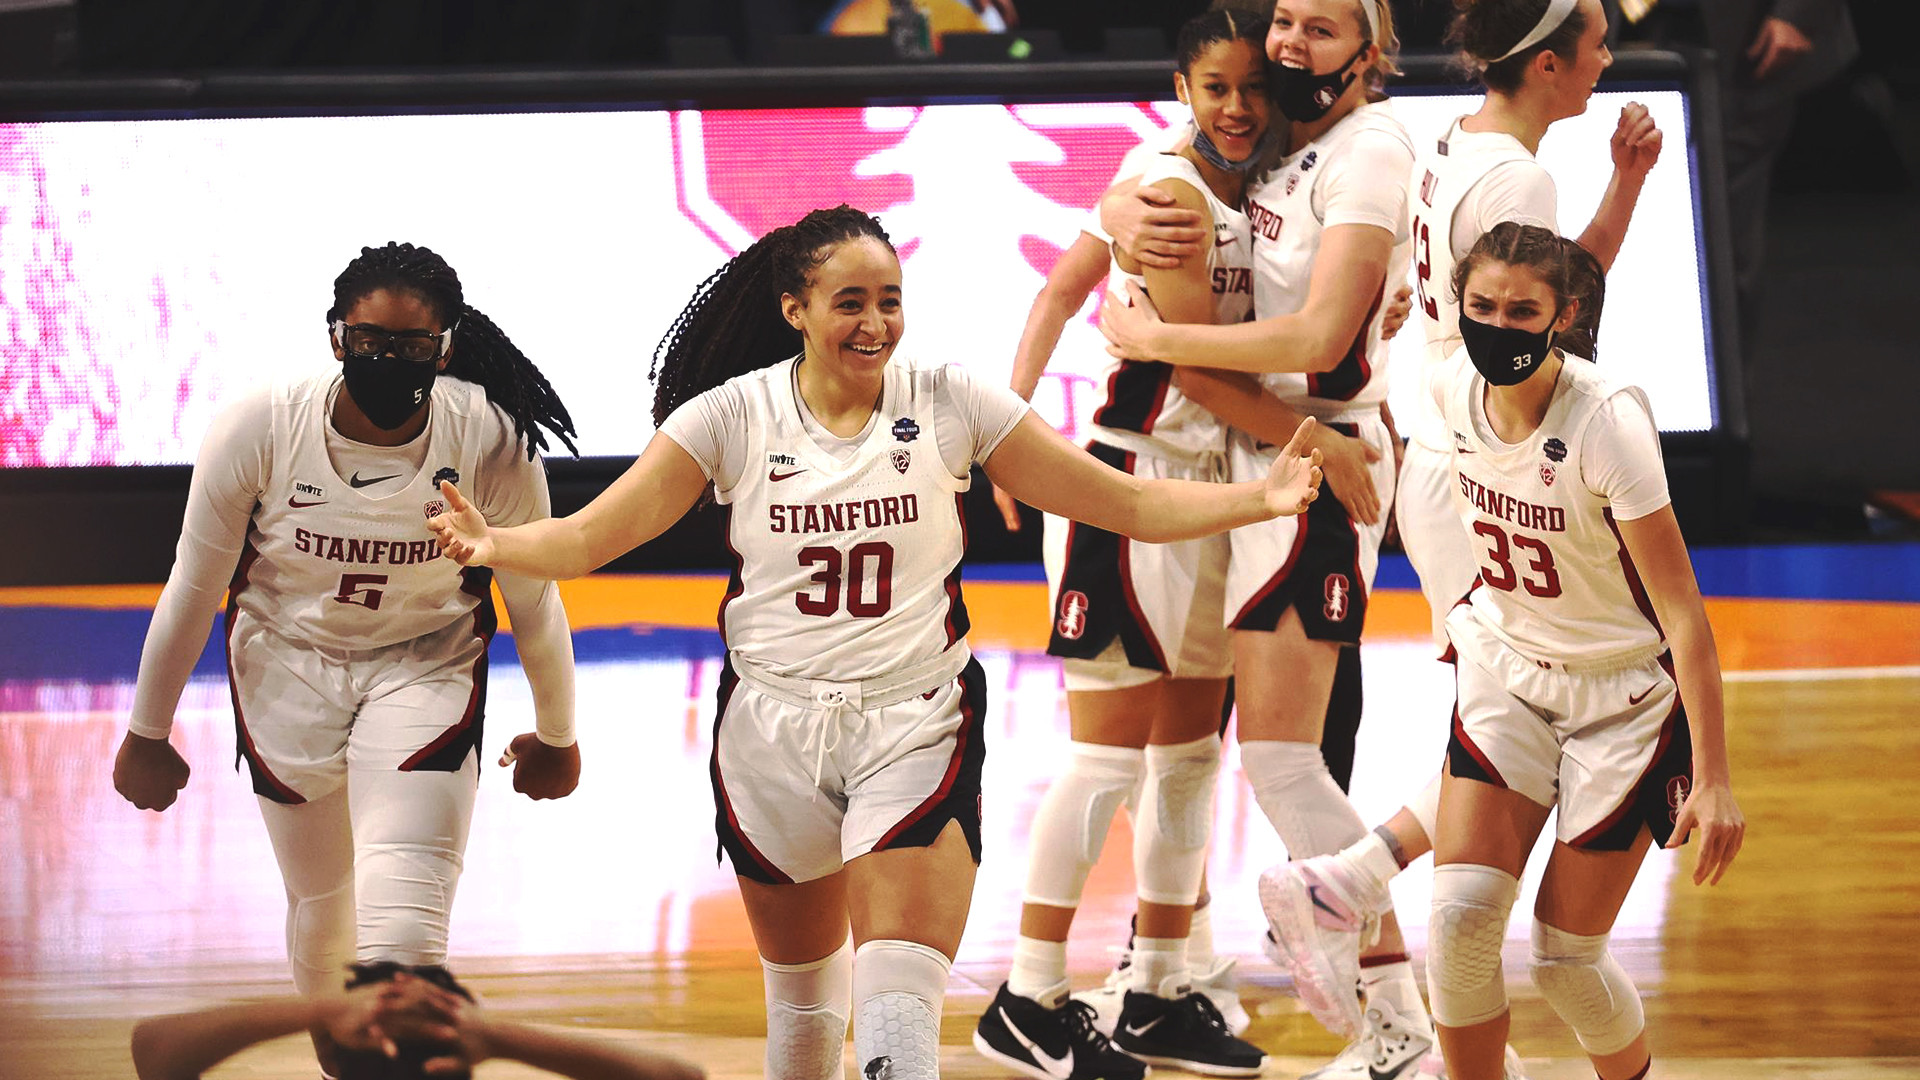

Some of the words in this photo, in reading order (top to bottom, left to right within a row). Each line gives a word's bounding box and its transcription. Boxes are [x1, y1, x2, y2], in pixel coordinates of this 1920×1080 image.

[1513, 354, 1531, 370] 33
[414, 388, 423, 404] 5
[896, 459, 908, 471] 12
[769, 493, 919, 534] STANFORD
[1458, 471, 1567, 532] STANFORD
[1472, 519, 1563, 598] 33
[334, 573, 388, 611] 5
[795, 541, 894, 618] 30
